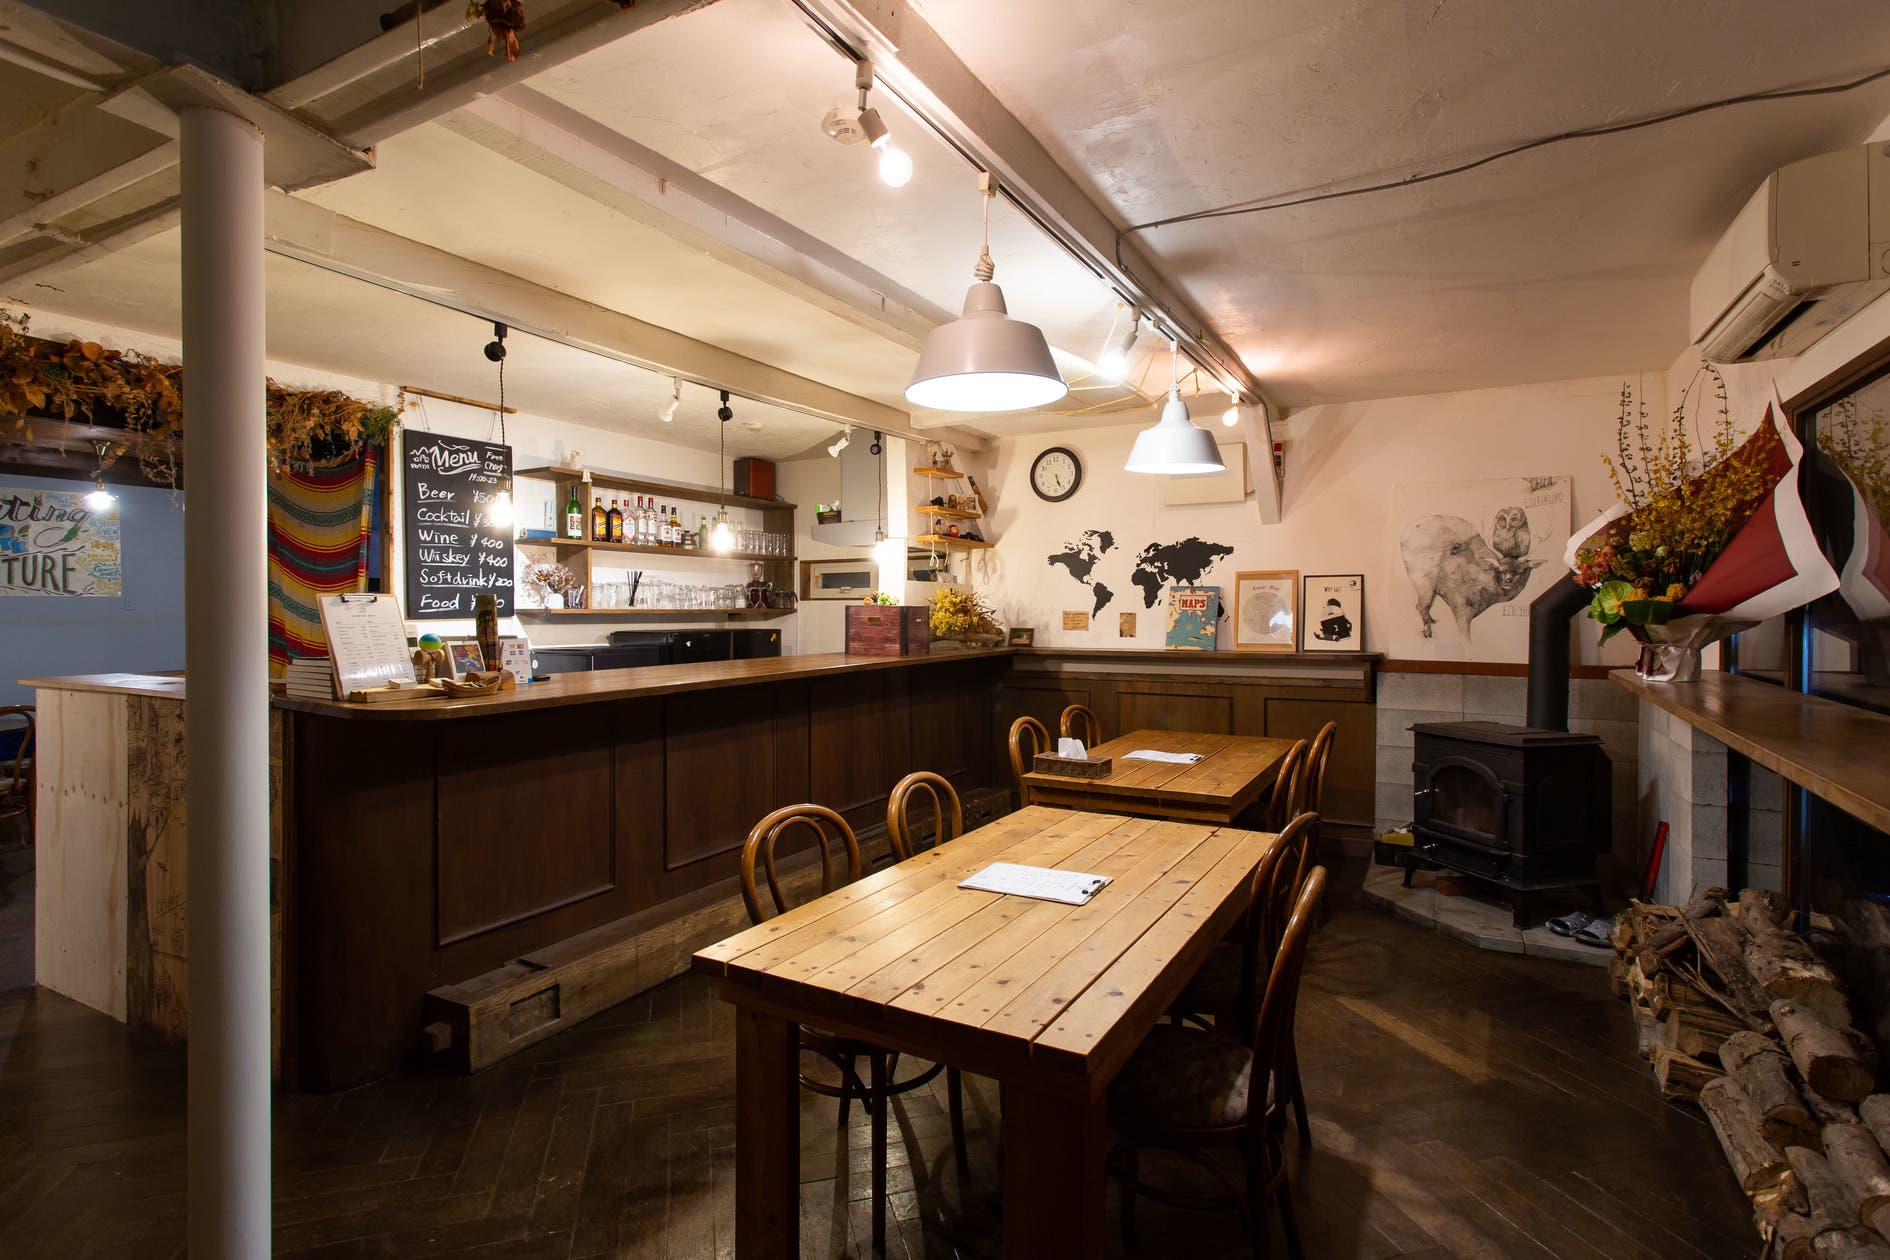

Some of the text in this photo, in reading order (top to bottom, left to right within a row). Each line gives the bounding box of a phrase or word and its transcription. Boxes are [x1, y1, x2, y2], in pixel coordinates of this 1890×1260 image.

[429, 446, 481, 469] Menu
[418, 482, 455, 500] Beer
[418, 507, 470, 524] Cocktail
[419, 529, 459, 544] Wine
[420, 592, 460, 609] Food
[1181, 599, 1206, 608] MAPS
